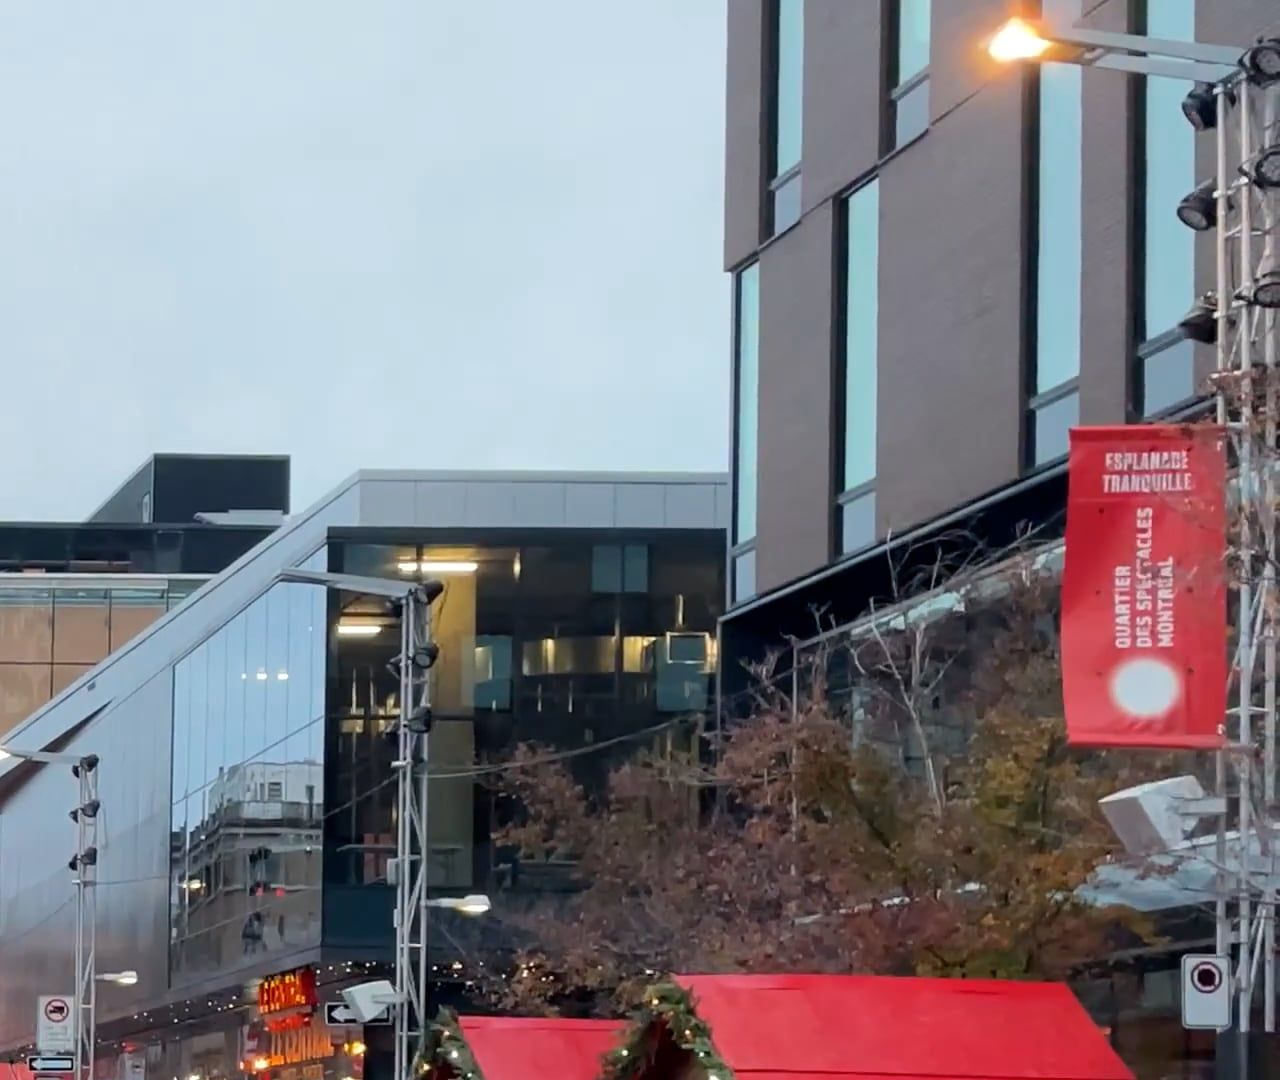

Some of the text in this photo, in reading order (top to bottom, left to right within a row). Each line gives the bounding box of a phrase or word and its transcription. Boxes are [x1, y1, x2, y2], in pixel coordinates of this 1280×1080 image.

[1103, 473, 1192, 493] TRANQUILLE
[1105, 451, 1189, 470] ESPLANADE
[1136, 507, 1153, 647] DES SPECTACLES
[1115, 566, 1131, 648] QUARTIER
